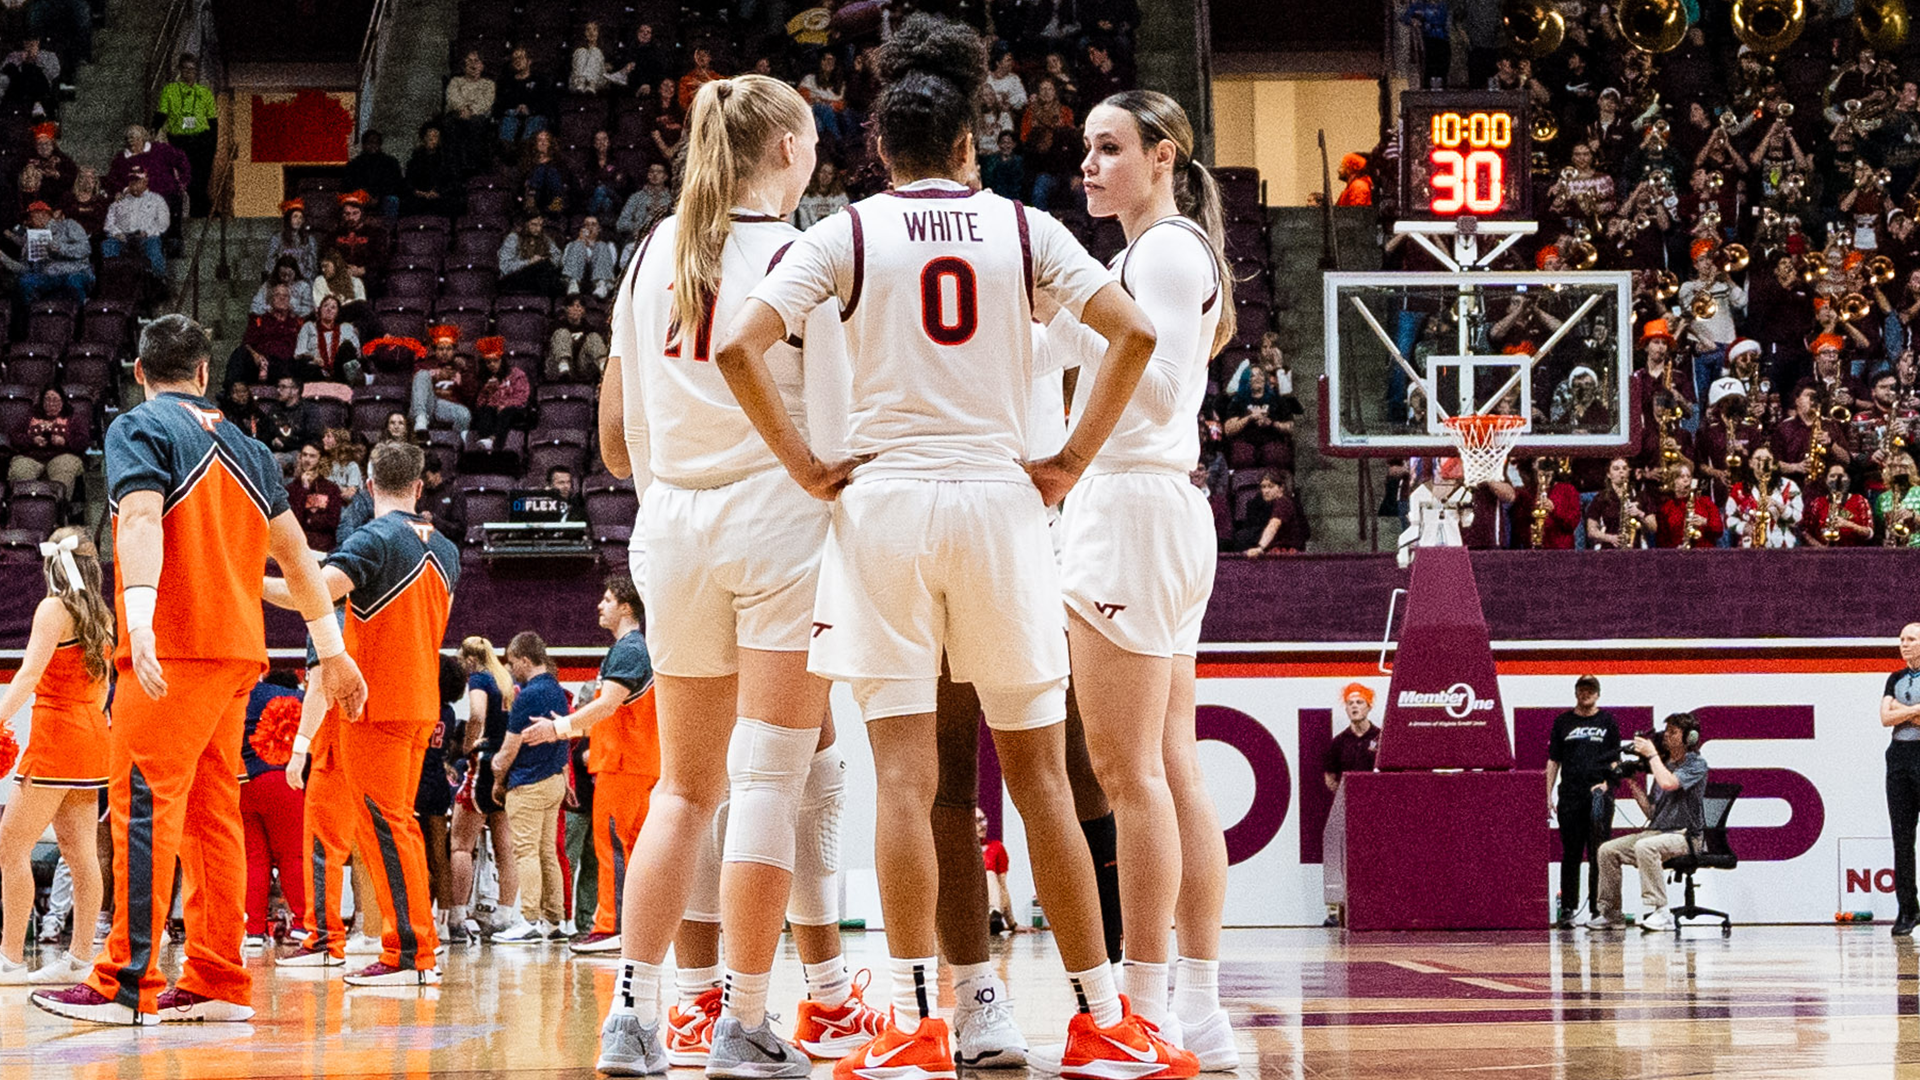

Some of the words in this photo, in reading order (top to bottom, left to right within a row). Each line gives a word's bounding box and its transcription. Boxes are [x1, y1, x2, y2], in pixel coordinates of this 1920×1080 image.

[1432, 112, 1511, 148] 10:00
[1431, 149, 1503, 212] 30
[903, 210, 984, 242] WHITE
[920, 256, 978, 346] 0
[1094, 601, 1127, 619] VT
[813, 622, 833, 638] T
[1568, 727, 1607, 738] ACCN
